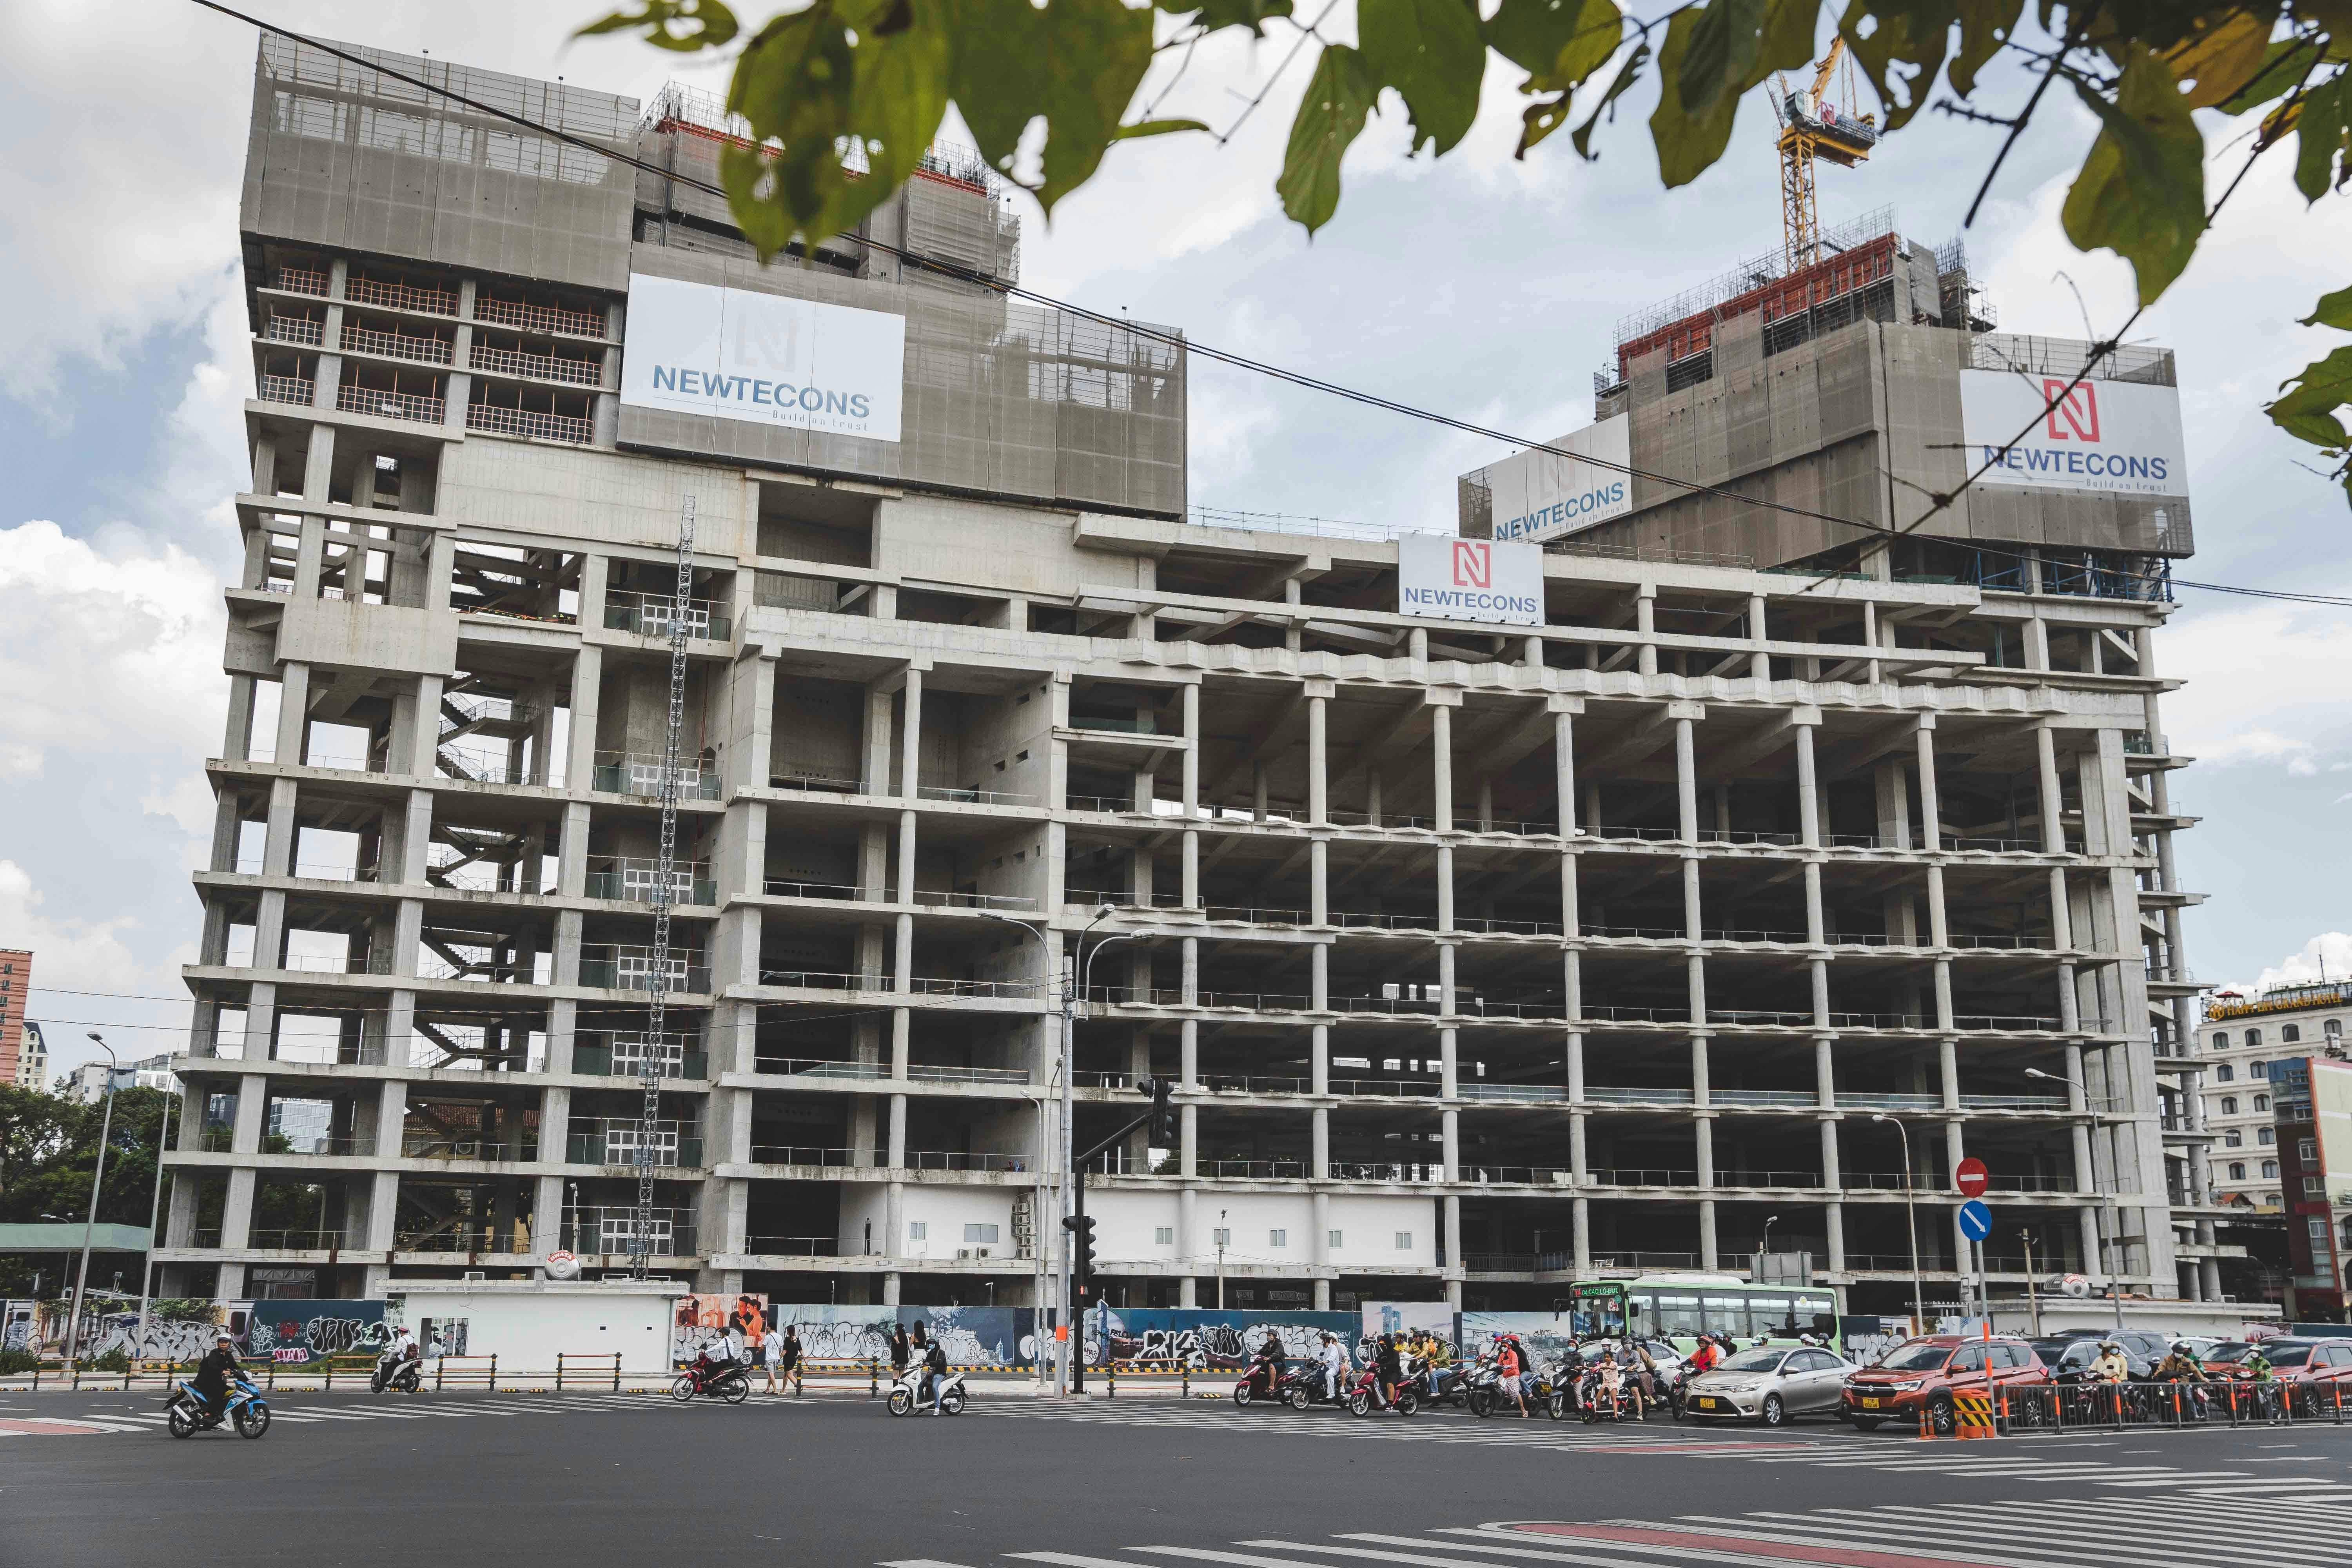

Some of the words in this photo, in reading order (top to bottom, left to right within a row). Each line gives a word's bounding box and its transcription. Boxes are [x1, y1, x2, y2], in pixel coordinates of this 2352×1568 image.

[653, 365, 870, 418] NEWTECONS
[773, 410, 805, 423] Build
[833, 419, 869, 431] trust
[1984, 445, 2167, 479] NEWTECONS
[2086, 478, 2114, 489] Build
[2136, 482, 2167, 492] trust
[1496, 482, 1624, 541] NEWTECONS
[1405, 587, 1536, 613] NEWTECONS
[1609, 1298, 1617, 1310] 34
